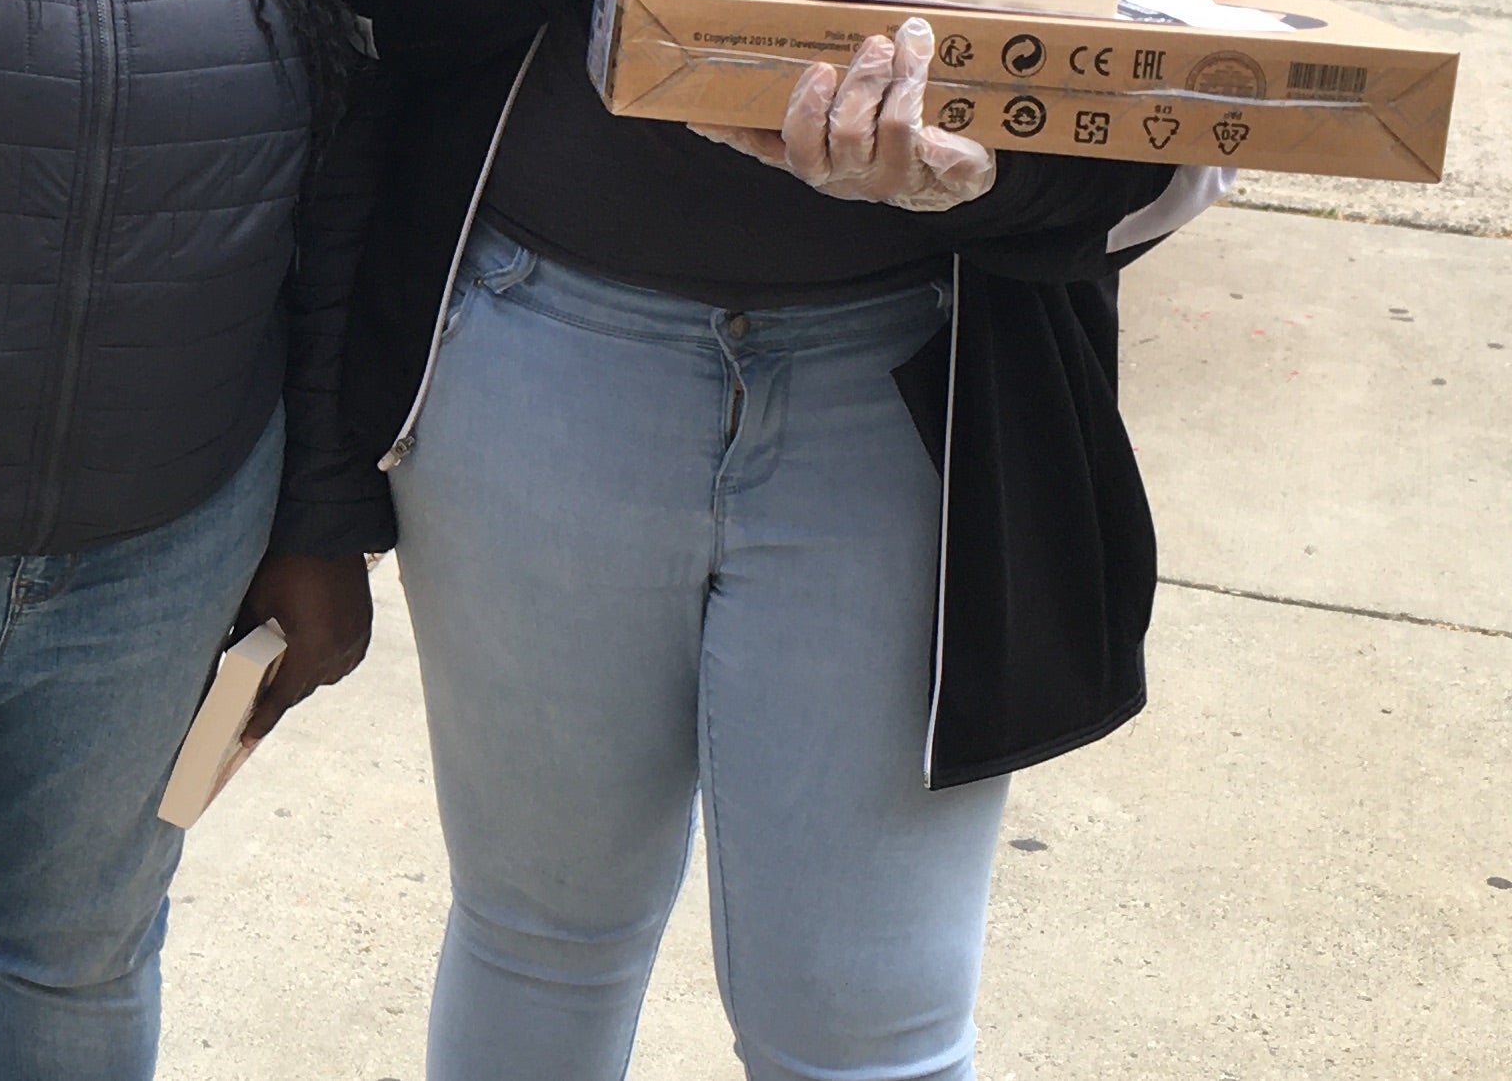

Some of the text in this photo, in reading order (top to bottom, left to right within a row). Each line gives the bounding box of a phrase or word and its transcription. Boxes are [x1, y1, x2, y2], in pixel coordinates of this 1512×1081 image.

[704, 32, 747, 46] Copyright
[749, 35, 773, 47] 2015
[775, 36, 788, 48] HP
[790, 38, 851, 52] Development
[1070, 45, 1113, 77] CE
[1133, 49, 1167, 80] EAC
[1221, 128, 1240, 142] 20
